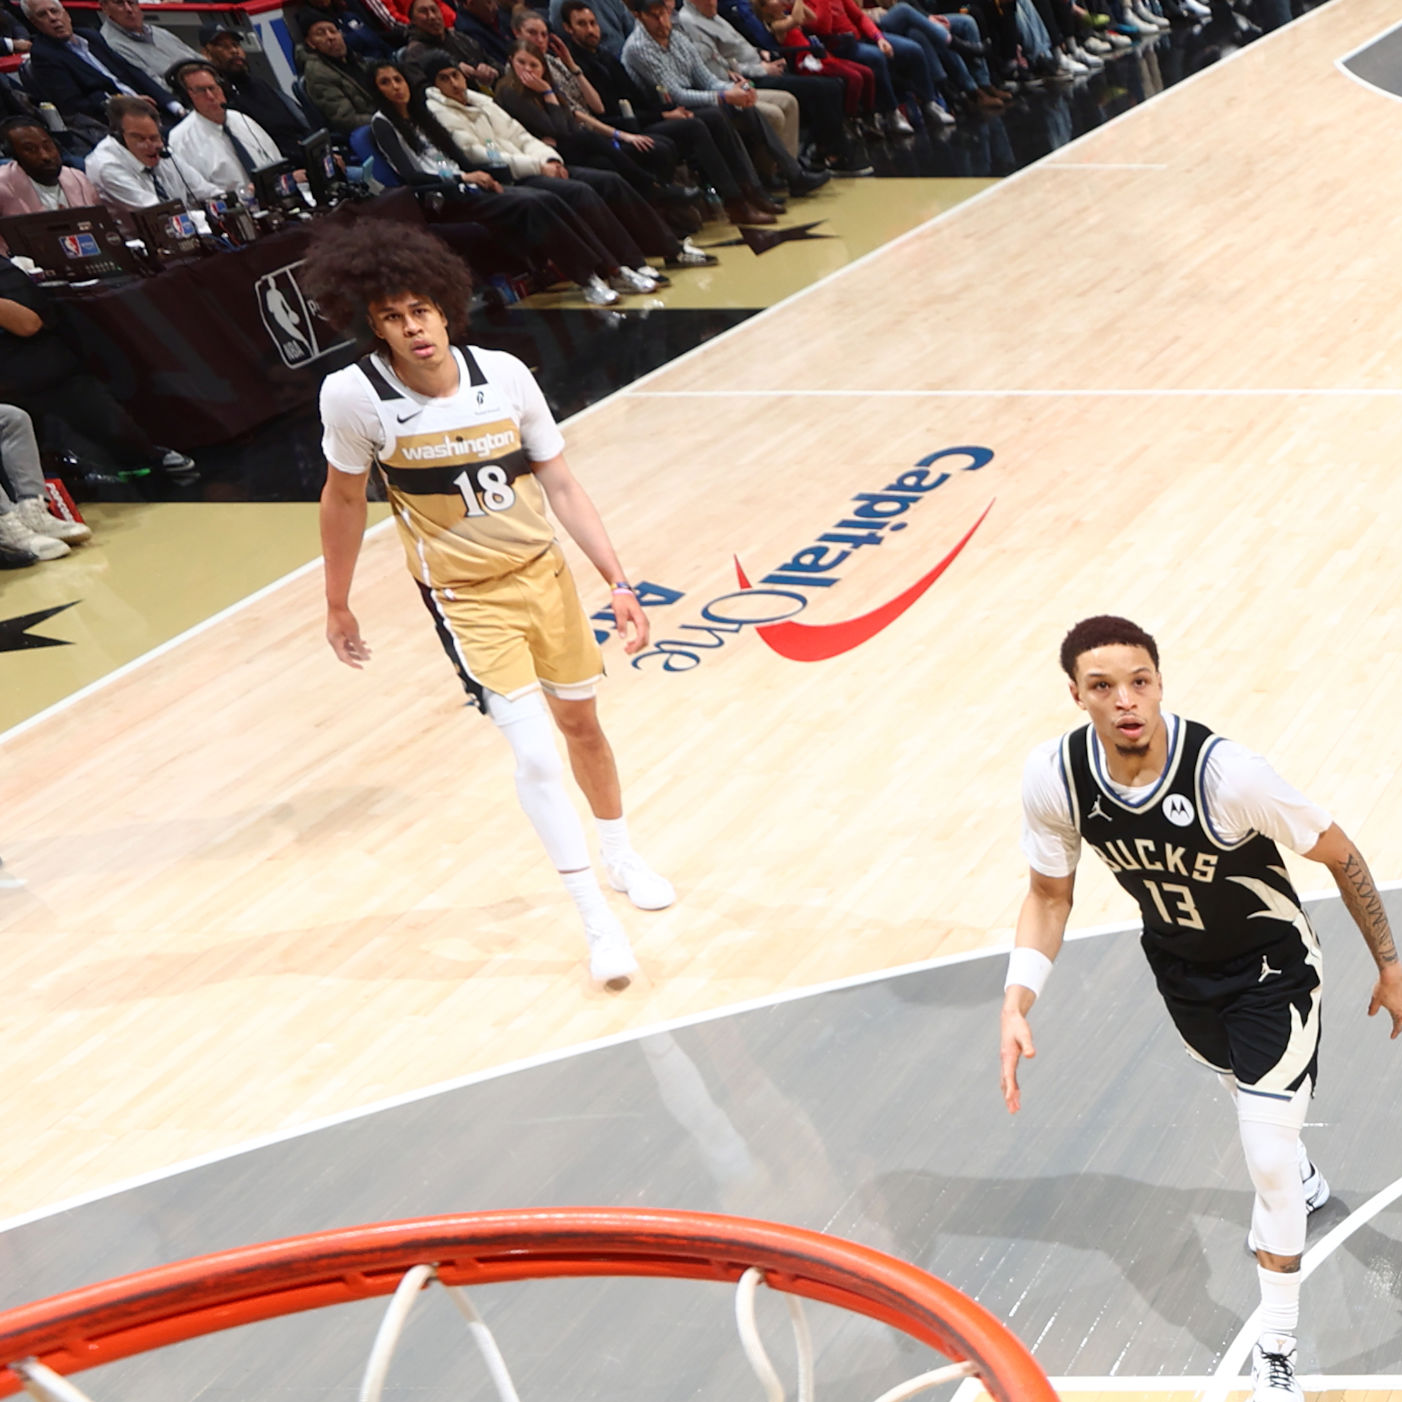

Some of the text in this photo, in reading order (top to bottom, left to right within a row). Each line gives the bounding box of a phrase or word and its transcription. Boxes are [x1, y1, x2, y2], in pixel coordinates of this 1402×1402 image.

[401, 430, 515, 461] washington
[453, 465, 516, 518] 18
[758, 445, 995, 588] Capital
[631, 589, 808, 673] One
[1143, 880, 1205, 930] 13
